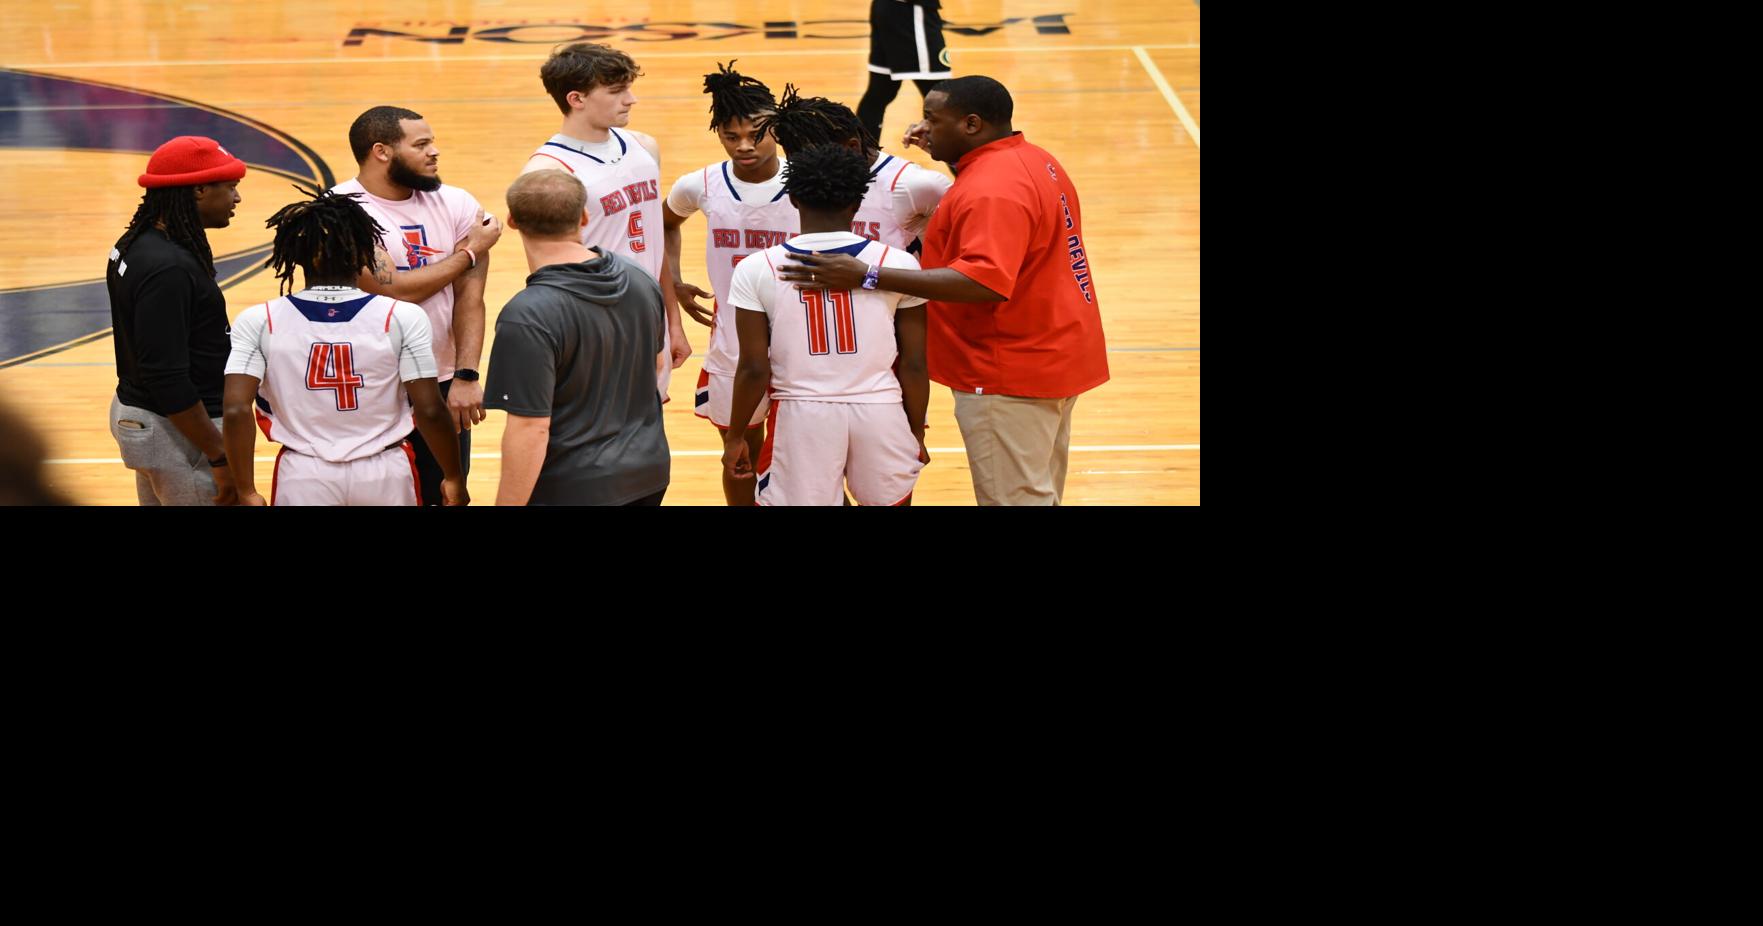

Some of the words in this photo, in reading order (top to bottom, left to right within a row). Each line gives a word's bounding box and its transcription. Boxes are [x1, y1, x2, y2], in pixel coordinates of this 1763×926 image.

[343, 13, 1075, 46] JACKSON
[600, 190, 627, 216] RED
[623, 179, 658, 206] DEVILS
[628, 210, 645, 253] 5
[712, 228, 740, 248] RED
[744, 229, 800, 249] DEVIL
[799, 288, 857, 356] 11
[305, 342, 364, 411] 4
